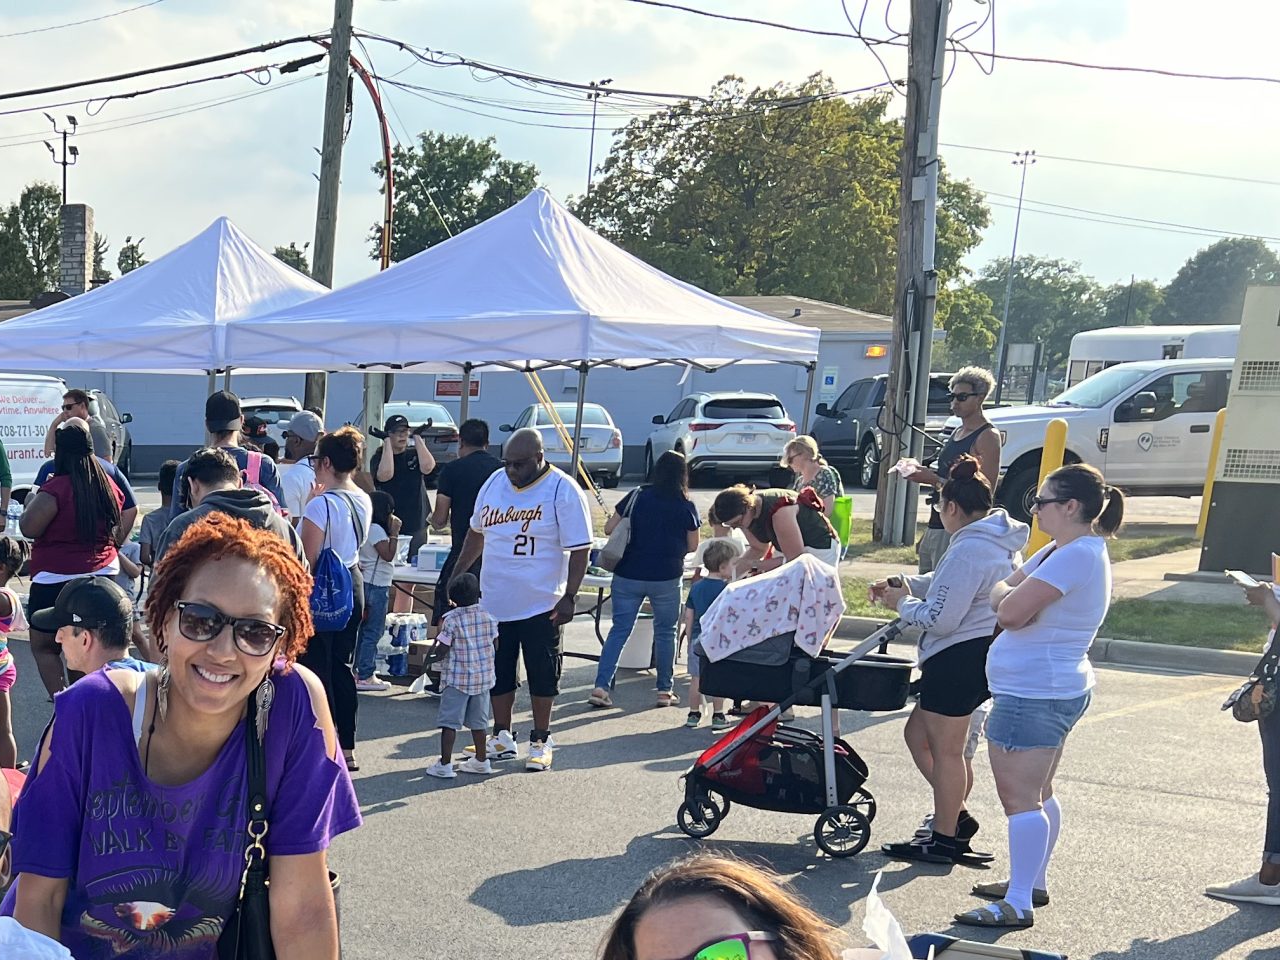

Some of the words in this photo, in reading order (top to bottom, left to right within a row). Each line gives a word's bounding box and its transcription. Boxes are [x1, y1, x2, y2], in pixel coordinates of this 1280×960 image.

[0, 395, 10, 403] We
[24, 406, 60, 415] Anywhere
[481, 504, 543, 533] Pittsburgh
[513, 534, 535, 556] 21
[89, 827, 154, 856] WALK
